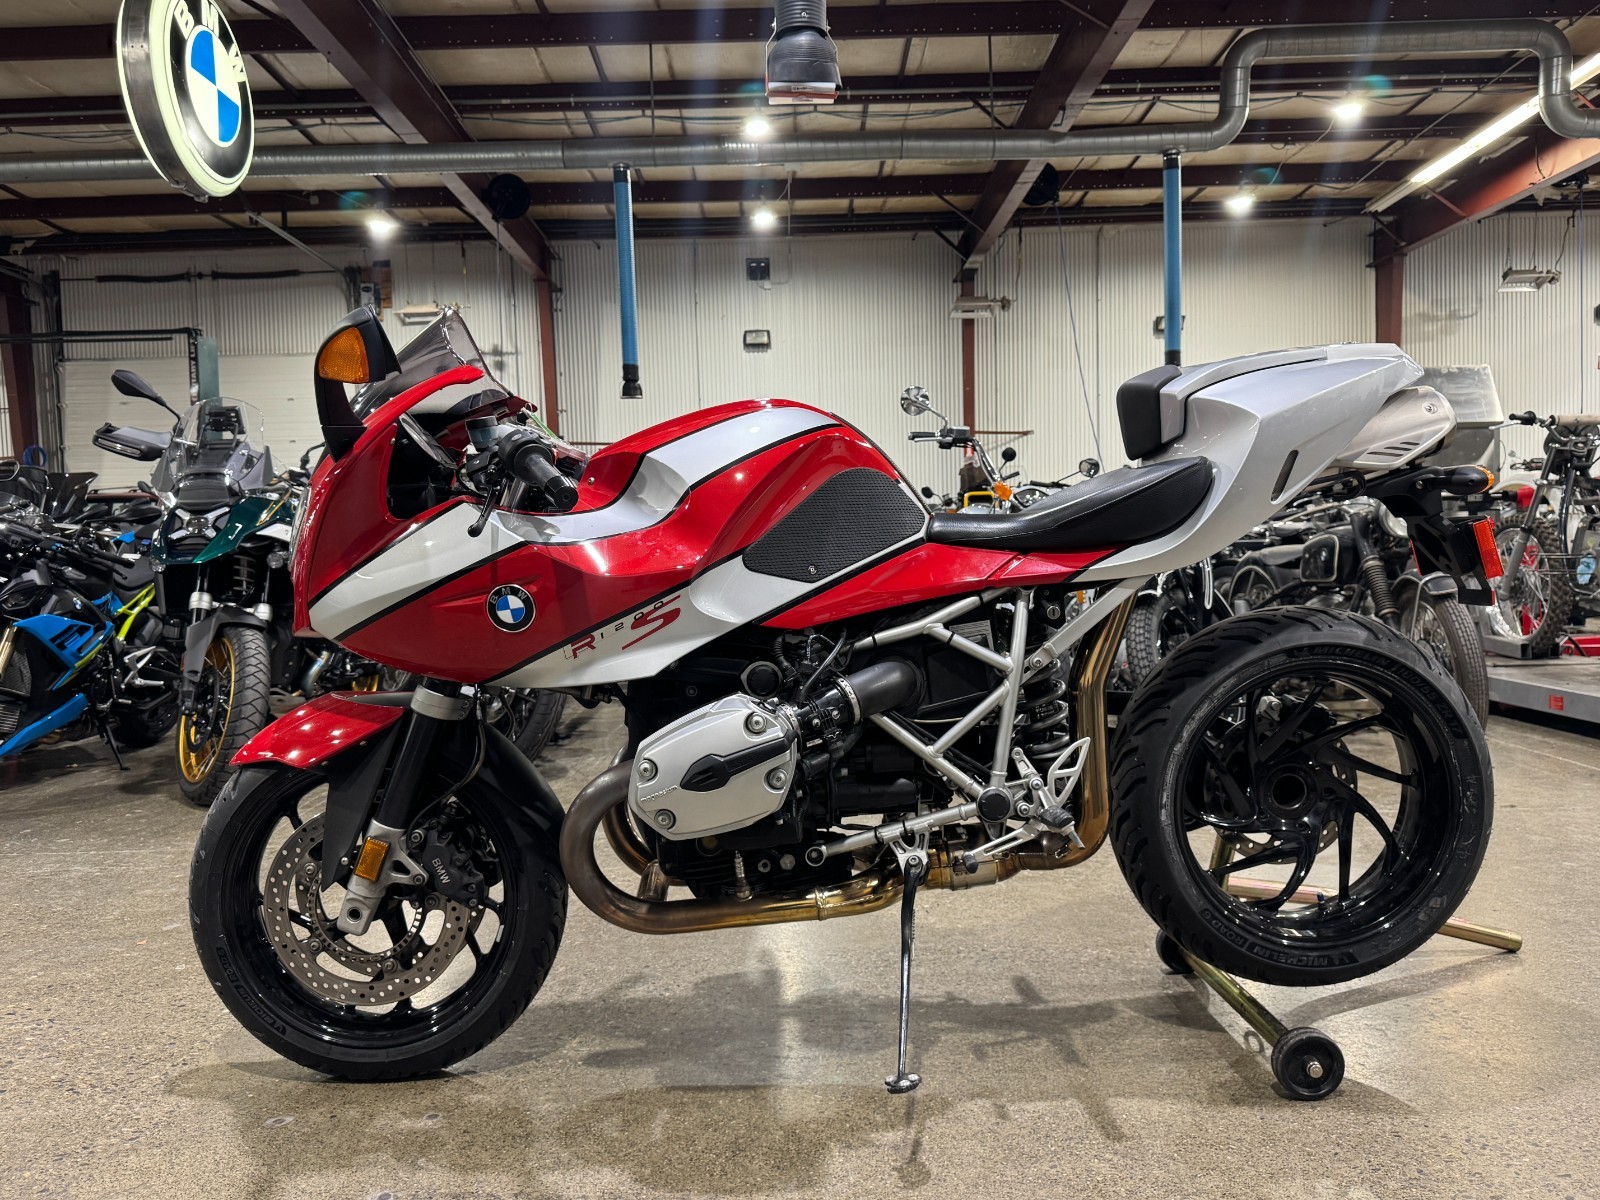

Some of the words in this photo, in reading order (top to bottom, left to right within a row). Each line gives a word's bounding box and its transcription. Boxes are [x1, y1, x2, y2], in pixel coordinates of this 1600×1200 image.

[174, 0, 247, 83] BMW
[490, 587, 528, 604] BMW
[1313, 644, 1390, 667] MICHELIN
[432, 857, 451, 884] BMW
[1211, 919, 1244, 946] ROAD
[220, 956, 237, 981] ROAD
[1253, 945, 1328, 967] MICHELIN
[237, 984, 274, 1025] MICHELIN
